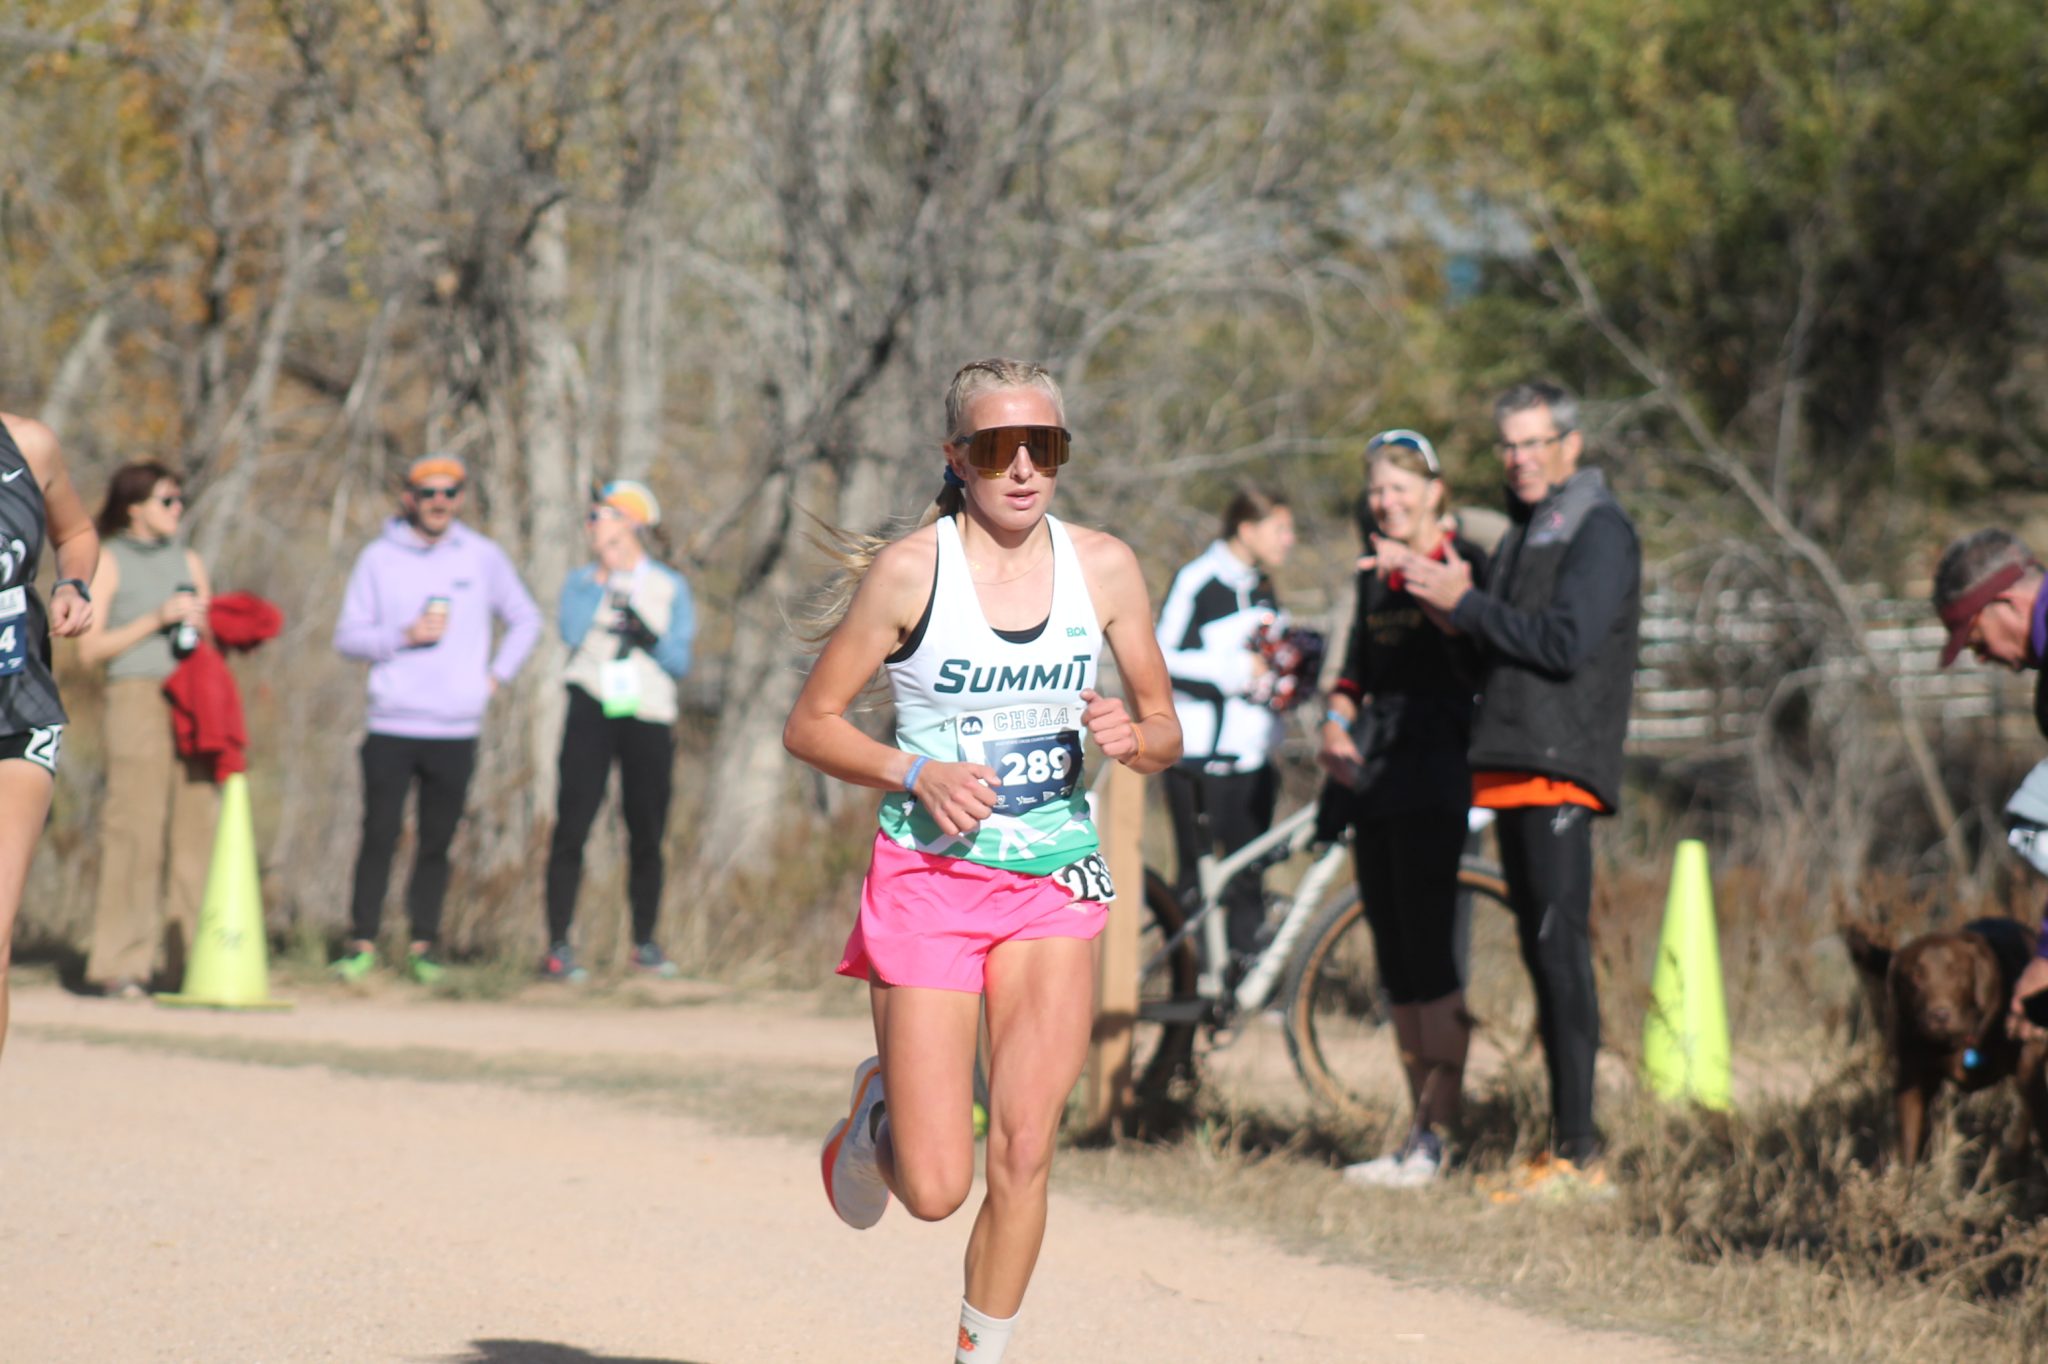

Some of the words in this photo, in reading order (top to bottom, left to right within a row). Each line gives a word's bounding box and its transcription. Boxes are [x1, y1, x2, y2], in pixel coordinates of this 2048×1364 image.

[934, 654, 1091, 694] SUMMIT
[961, 721, 982, 733] 4A
[993, 707, 1069, 731] CHSAA
[1001, 746, 1071, 786] 289
[1061, 853, 1115, 901] 28
